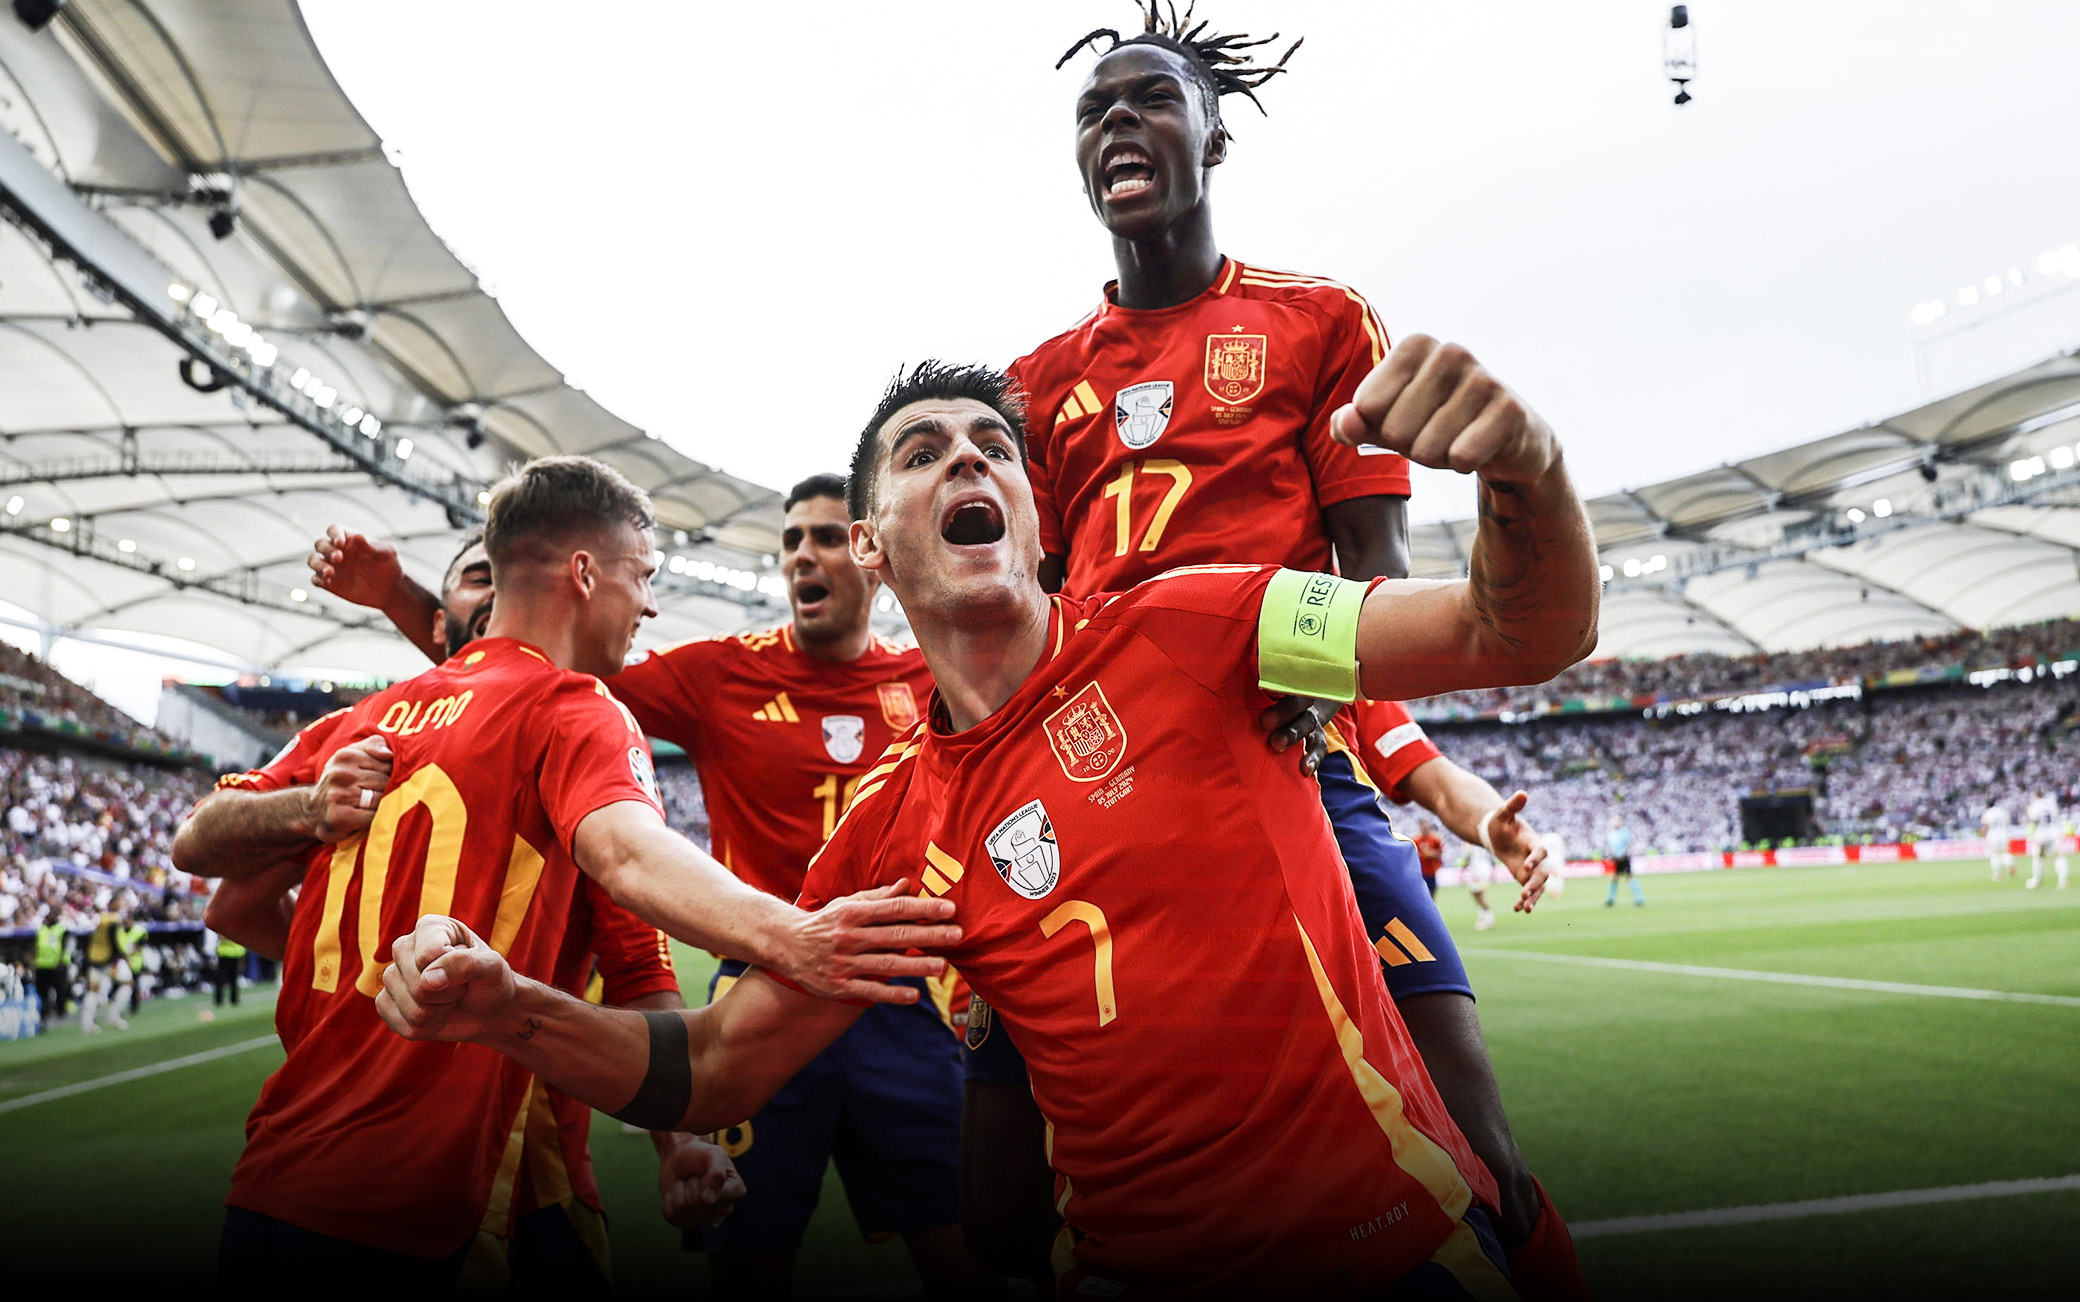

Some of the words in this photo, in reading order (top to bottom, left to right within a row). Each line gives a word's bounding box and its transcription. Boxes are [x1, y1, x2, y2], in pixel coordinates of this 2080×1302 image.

[1103, 459, 1193, 557] 17
[376, 689, 474, 736] OLMO
[1087, 788, 1105, 803] SPAIN
[1108, 765, 1136, 787] GERMANY
[1097, 795, 1106, 805] 05
[1104, 786, 1118, 800] JULY
[1118, 776, 1134, 790] 2024
[1103, 784, 1134, 810] STUTTGART
[988, 833, 999, 846] UEFA
[998, 815, 1019, 834] NATIONS
[1018, 803, 1038, 817] LEAGUE
[311, 761, 468, 998] 10
[1029, 884, 1050, 897] WINNER
[1038, 900, 1117, 1027] 7
[1349, 1200, 1409, 1242] HEAT.RDY
